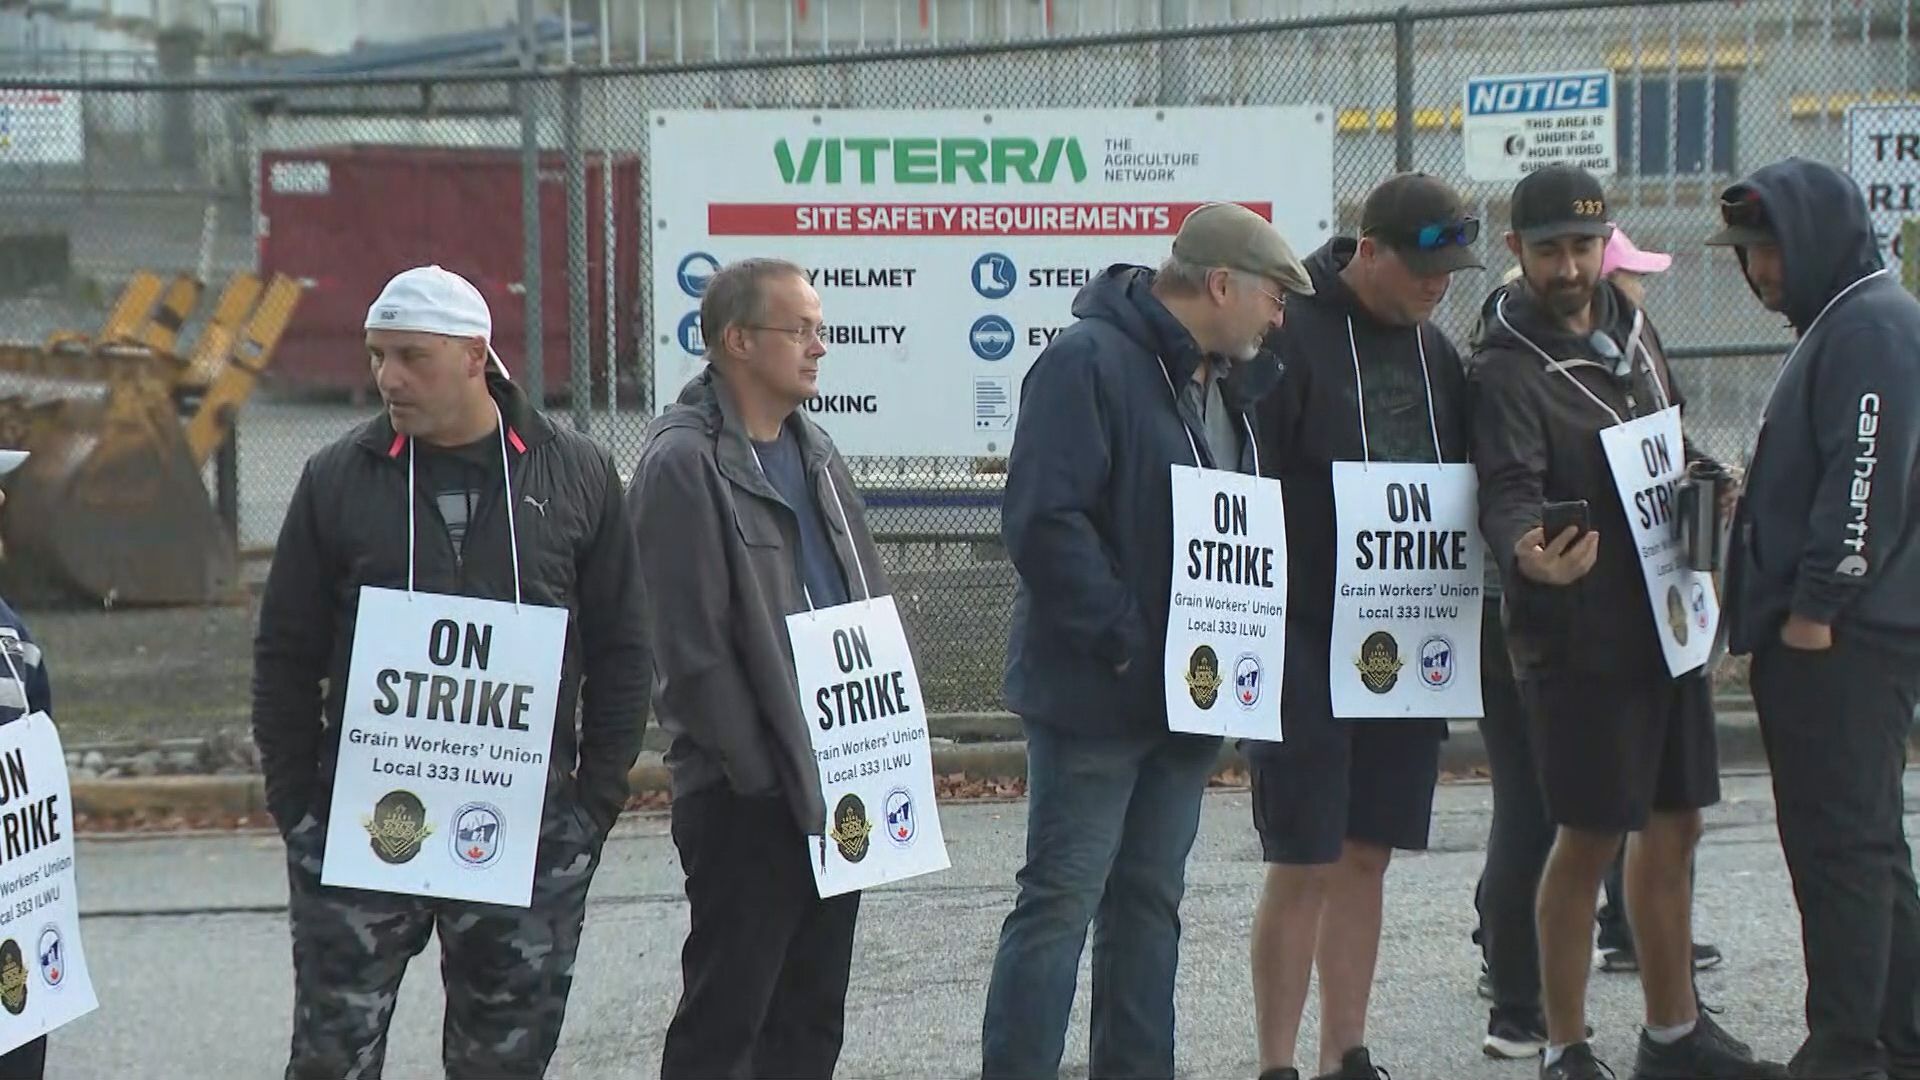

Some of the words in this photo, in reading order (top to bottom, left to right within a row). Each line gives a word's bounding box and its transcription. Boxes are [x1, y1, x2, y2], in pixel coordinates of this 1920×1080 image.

[1473, 78, 1604, 113] NOTICE
[1525, 117, 1554, 129] THIS
[1557, 116, 1588, 128] AREA
[1592, 115, 1605, 126] IS
[1536, 132, 1578, 143] UNDER
[1104, 153, 1200, 167] AGRICULTURE
[1105, 138, 1132, 151] THE
[1528, 146, 1562, 158] HOUR
[1565, 143, 1604, 156] VIDEO
[773, 136, 1087, 185] VITERRA
[1105, 168, 1175, 182] NETWORK
[795, 205, 855, 230] SITE
[857, 205, 959, 231] SAFETY
[960, 205, 1170, 233] REQUIREMENTS
[824, 269, 917, 288] HELMET
[822, 325, 906, 344] IBILITY
[803, 394, 878, 413] OKING
[1641, 433, 1672, 478] ON
[1843, 392, 1880, 552] carhartt
[1214, 491, 1248, 536] ON
[1386, 482, 1432, 523] ON
[1187, 538, 1274, 588] STRIKE
[1356, 530, 1467, 571] STRIKE
[1174, 592, 1202, 609] Grain
[1252, 602, 1283, 617] Union
[1340, 583, 1376, 597] Grain
[1440, 583, 1480, 597] Union
[1187, 618, 1216, 633] Local
[1218, 620, 1237, 635] 333
[1239, 623, 1266, 638] ILWU
[1358, 606, 1393, 619] Local
[1397, 606, 1420, 619] 333
[1423, 606, 1458, 619] ILWU
[428, 618, 493, 671] ON
[832, 625, 873, 674] ON
[373, 669, 534, 732] STRIKE
[816, 671, 910, 731] STRIKE
[349, 728, 399, 749] Grain
[489, 745, 543, 765] Union
[892, 727, 926, 744] Union
[372, 757, 422, 778] Local
[426, 764, 460, 782] 333
[465, 769, 513, 788] ILWU
[827, 764, 857, 784] Local
[859, 760, 881, 776] 333
[882, 753, 912, 772] ILWU
[0, 794, 61, 866] RIKE
[43, 855, 73, 878] Union
[15, 898, 33, 918] 333
[34, 887, 61, 908] ILWU
